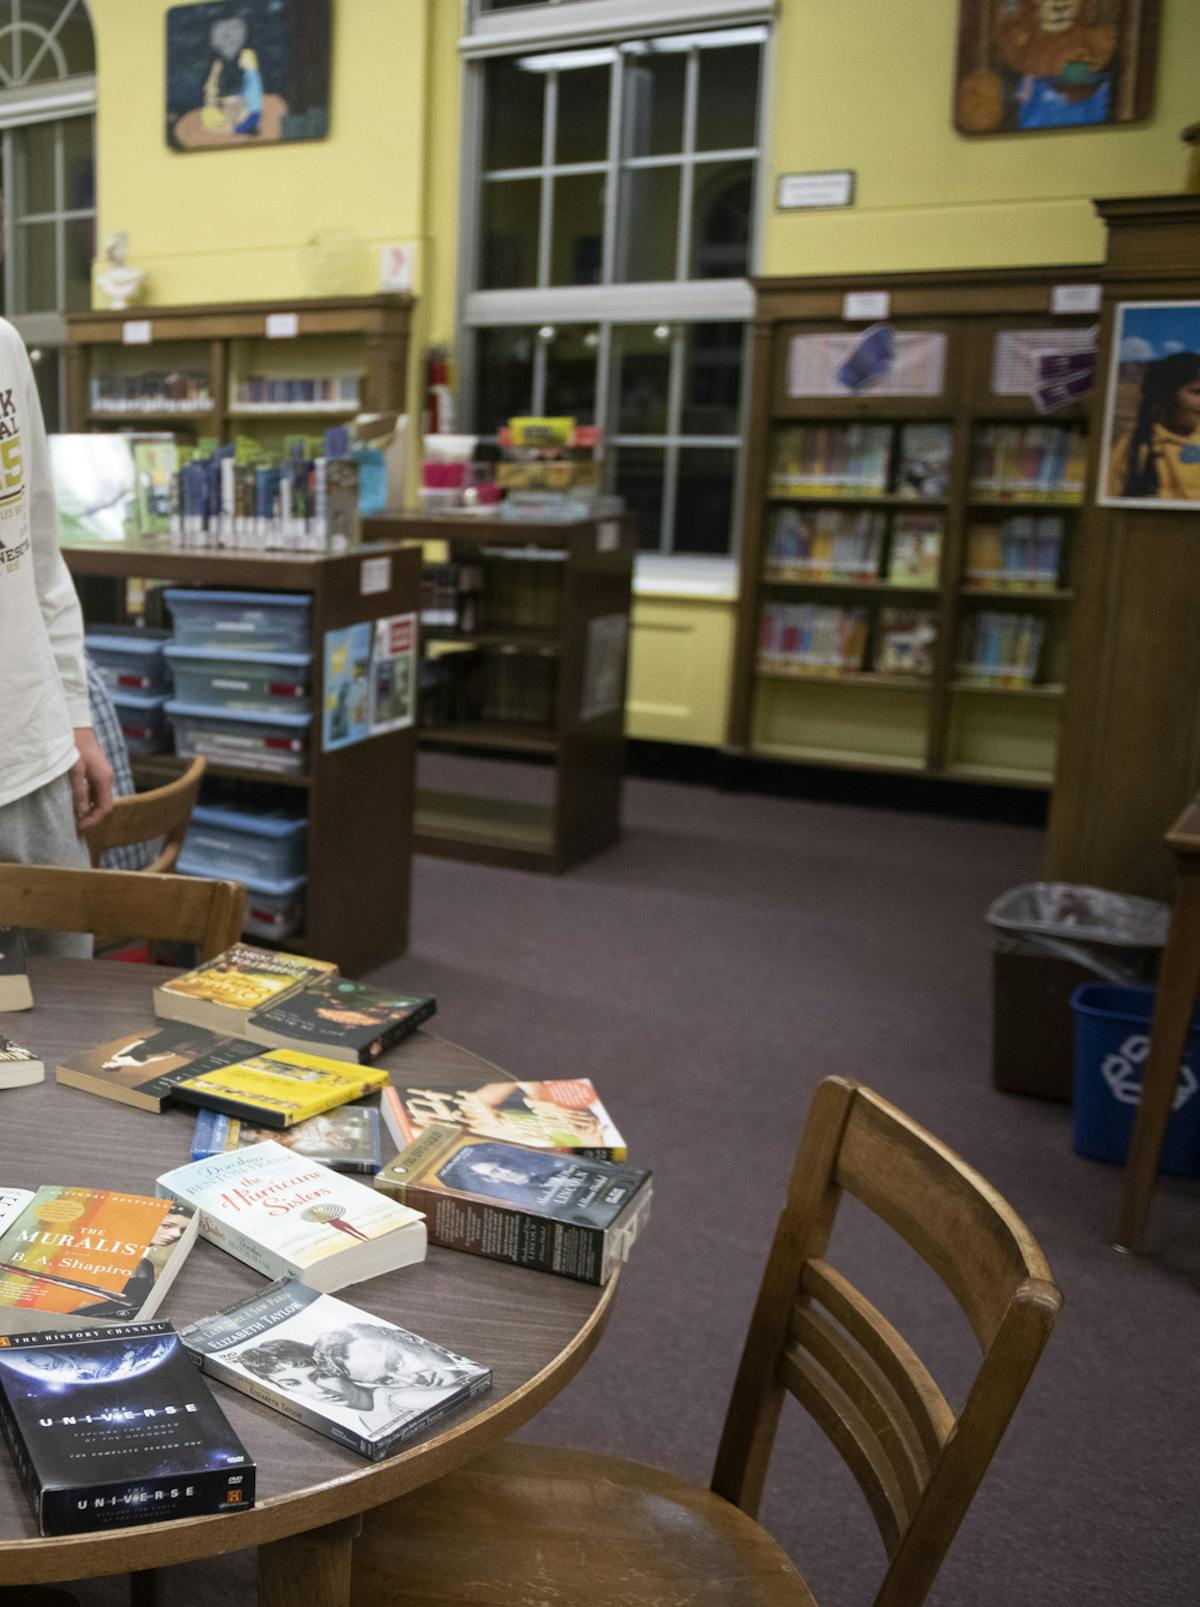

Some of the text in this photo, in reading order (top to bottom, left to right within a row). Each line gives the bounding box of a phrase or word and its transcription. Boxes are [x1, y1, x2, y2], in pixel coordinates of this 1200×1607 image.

[222, 1170, 322, 1212] Hurricane
[240, 1175, 261, 1188] the
[263, 1186, 332, 1217] Sisters
[16, 1228, 158, 1260] MURALIST
[80, 1226, 108, 1237] THE
[11, 1251, 133, 1278] B. A. Shapiro
[14, 1335, 39, 1345] THE
[44, 1330, 100, 1342] HISTORY
[106, 1323, 167, 1336] CHANNEL
[208, 1302, 303, 1350] ELIZABETH TAYLOR
[39, 1402, 200, 1428] UNIVERSE
[91, 1447, 139, 1457] COMPLETE
[77, 1486, 195, 1510] UNIVERSE
